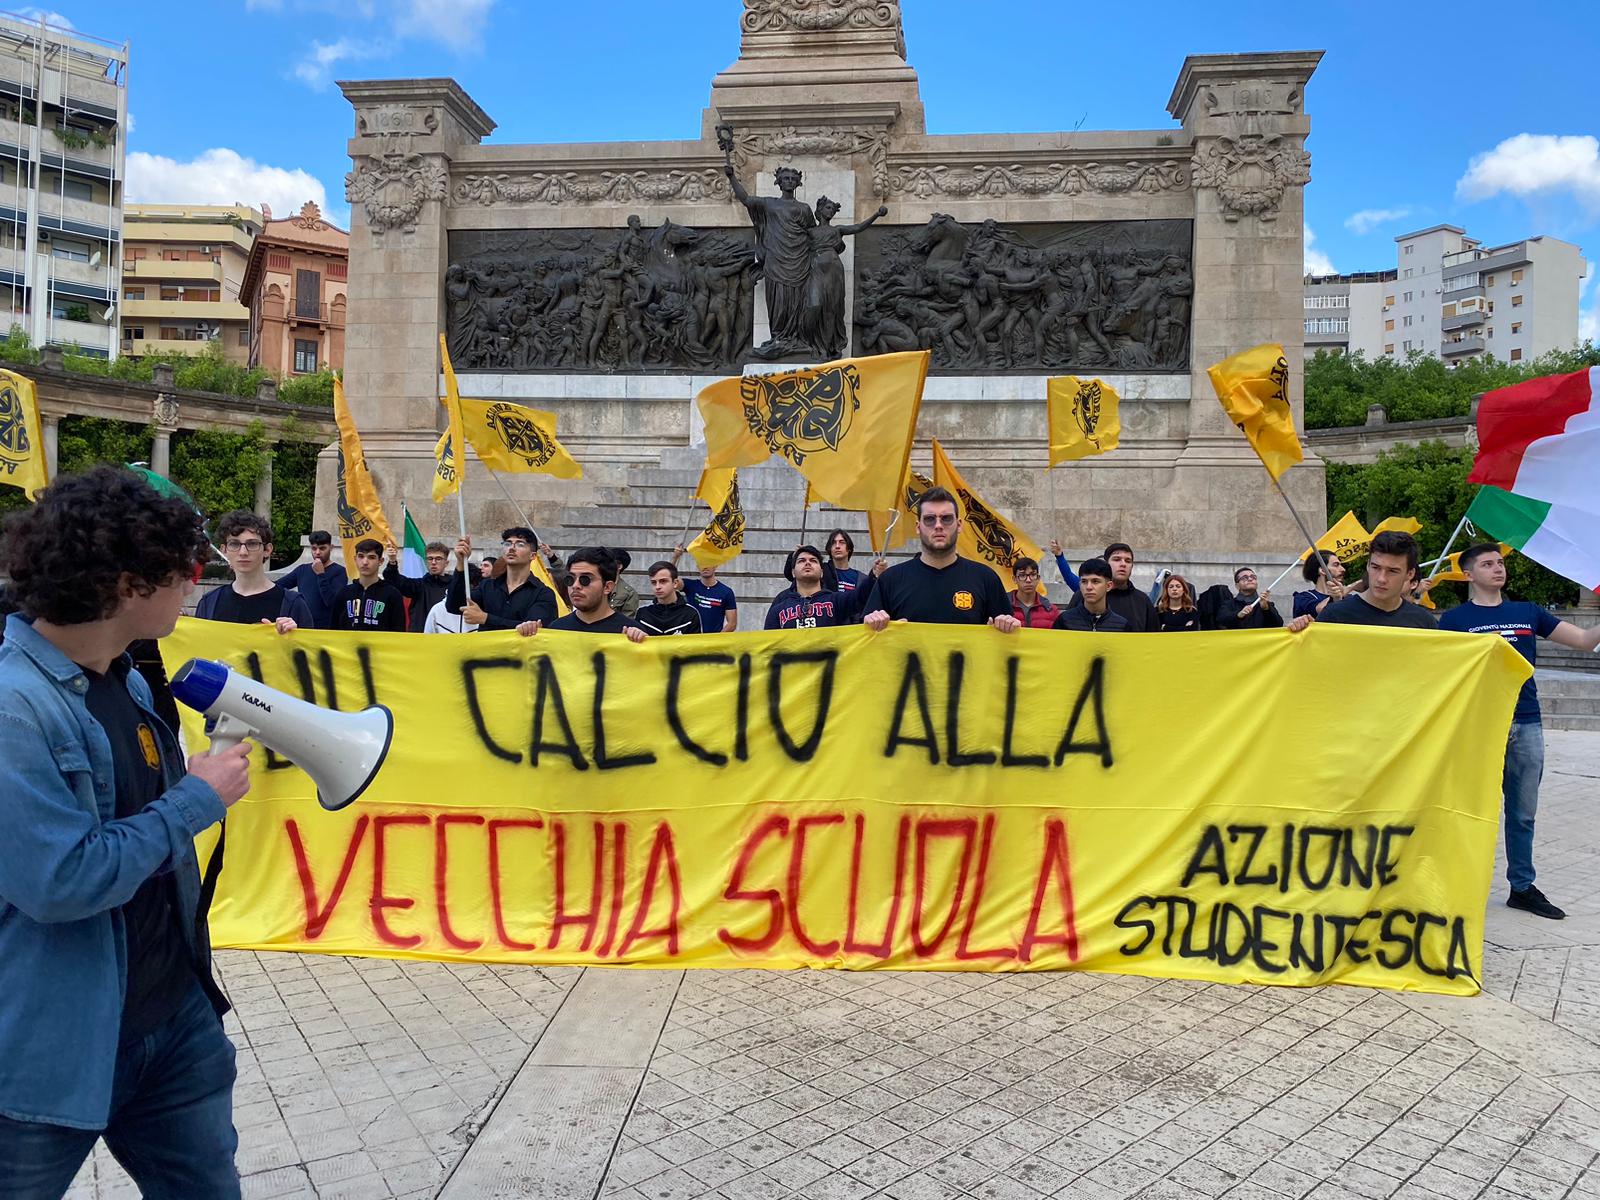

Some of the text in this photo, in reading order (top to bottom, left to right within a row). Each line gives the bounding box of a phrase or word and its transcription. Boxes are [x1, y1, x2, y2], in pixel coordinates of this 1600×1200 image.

[241, 692, 272, 714] KARMA
[459, 650, 838, 771] CALCIO
[884, 650, 1114, 769] ALLA
[284, 812, 1080, 962] VECCHIA SCUOLA
[1180, 822, 1416, 894] AZIONE
[1113, 895, 1482, 988] STUDENTESCA
